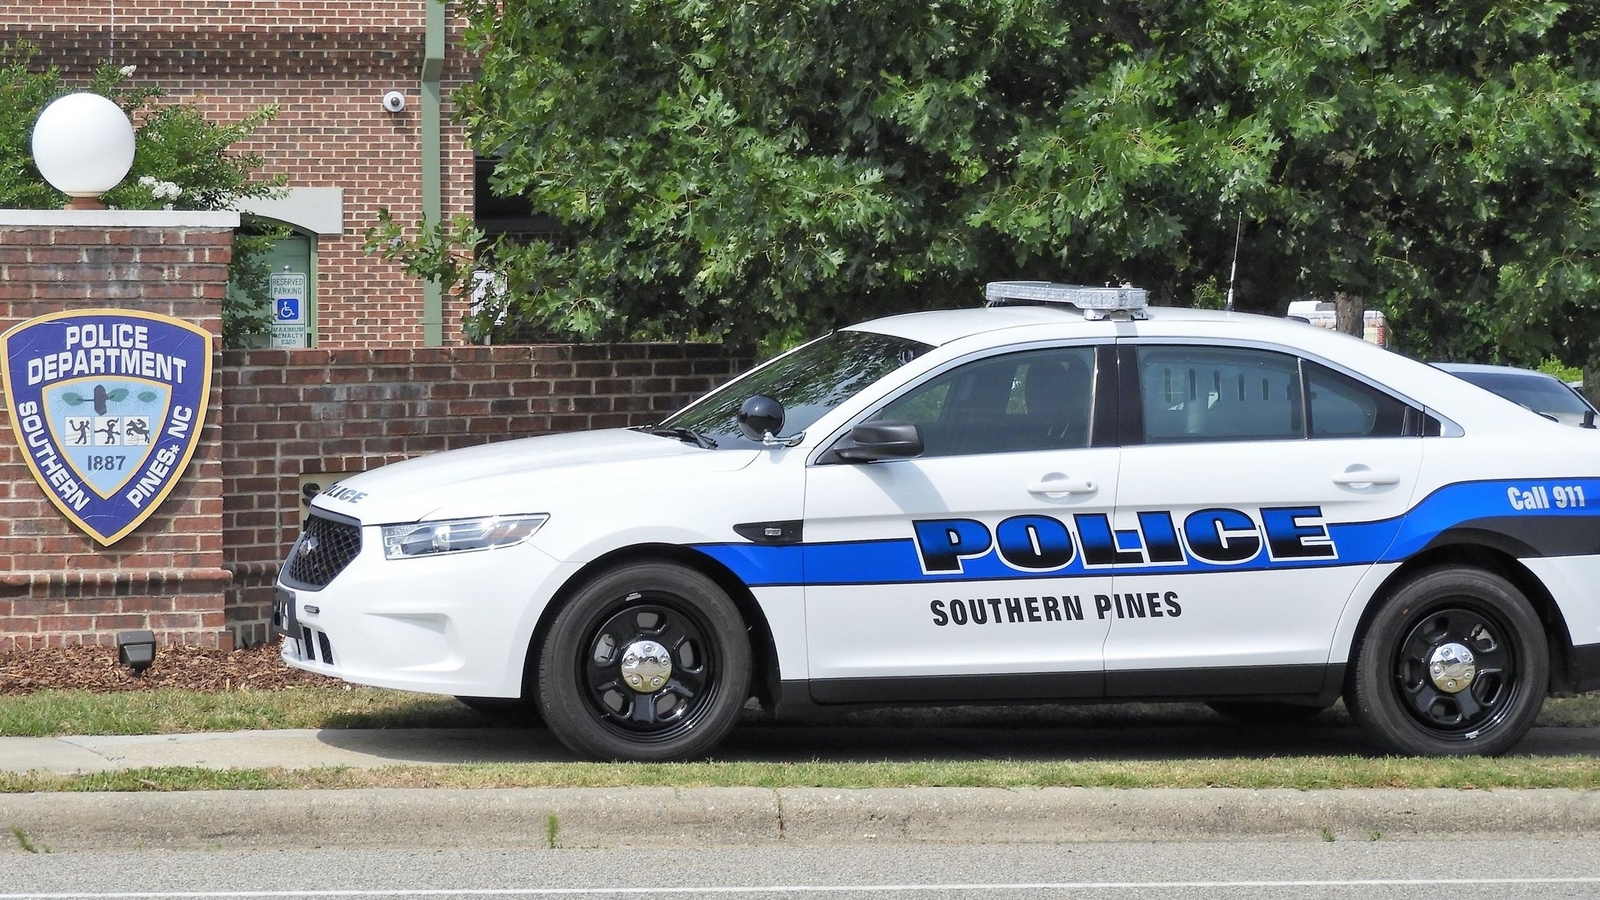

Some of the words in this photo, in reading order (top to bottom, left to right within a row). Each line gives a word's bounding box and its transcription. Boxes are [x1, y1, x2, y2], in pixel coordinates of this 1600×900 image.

[272, 278, 303, 286] RESERVED
[273, 287, 302, 295] PARKING
[66, 324, 148, 350] POLICE
[28, 349, 187, 386] DEPARTMENT
[18, 401, 90, 512] SOUTHERN
[125, 449, 176, 509] PINES
[168, 406, 192, 439] NC
[87, 455, 126, 471] 1887
[1507, 486, 1550, 511] Call
[1552, 485, 1585, 509] 911
[911, 505, 1339, 576] POLICE
[930, 595, 1084, 627] SOUTHERN
[1094, 590, 1182, 620] PINES
